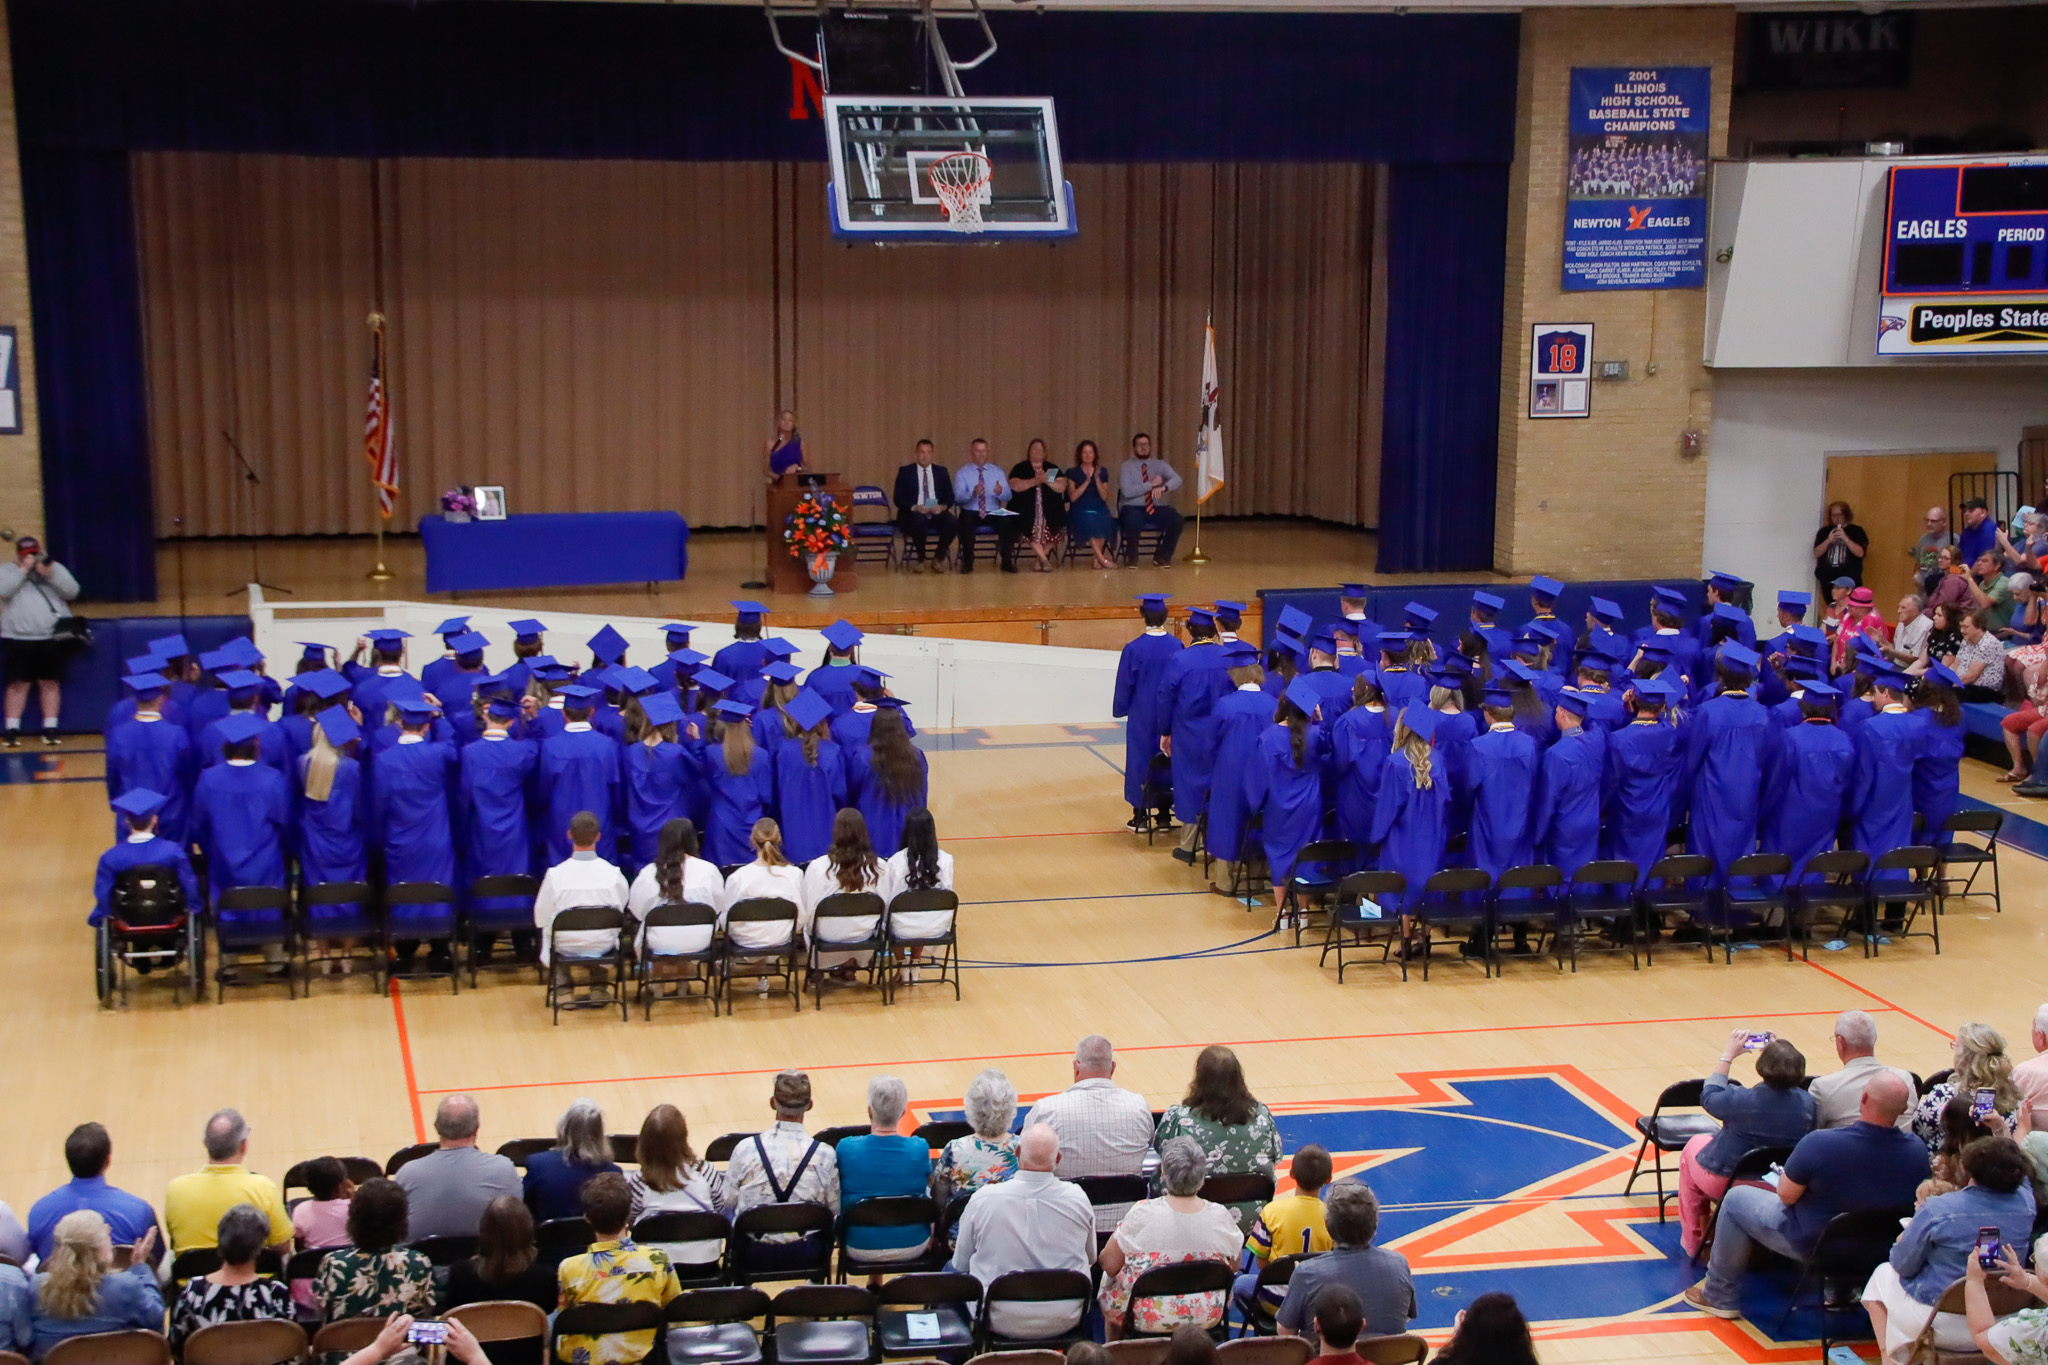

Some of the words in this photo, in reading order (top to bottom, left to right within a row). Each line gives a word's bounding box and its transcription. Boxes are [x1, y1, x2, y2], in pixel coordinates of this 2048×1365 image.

[1768, 18, 1899, 53] WIKK
[1628, 71, 1657, 81] 2001
[1614, 83, 1667, 94] ILLINOIS
[1600, 96, 1631, 107] HIGH
[1634, 95, 1683, 107] SCHOOL
[1588, 108, 1650, 120] BASEBALL
[1652, 107, 1691, 118] STATE
[1603, 120, 1676, 132] CHAMPIONS
[1573, 218, 1621, 229] NEWTON
[1647, 216, 1691, 228] EAGLES
[1896, 218, 1968, 240] EAGLES
[1997, 227, 2046, 242] PERIOD
[1919, 309, 1995, 333] Peoples
[1999, 307, 2048, 328] State
[1549, 344, 1577, 372] 18
[1301, 1227, 1312, 1254] 1
